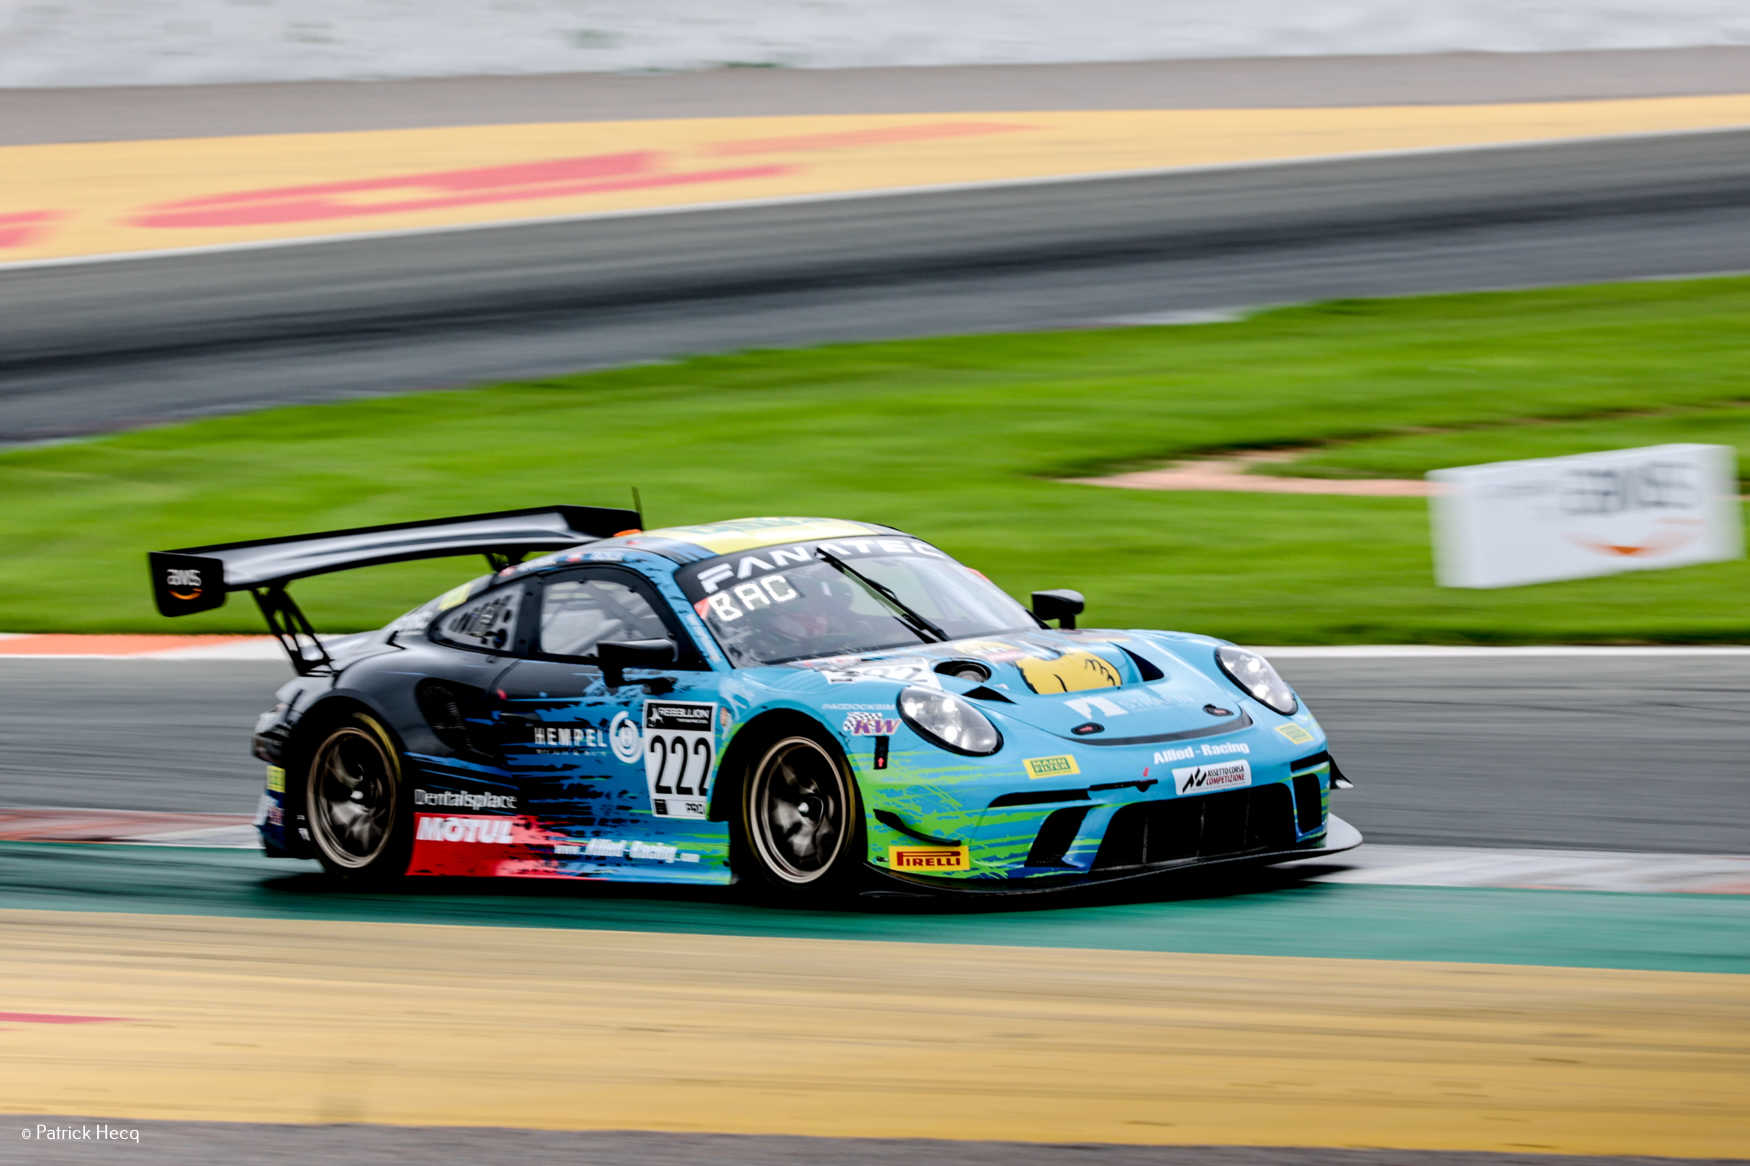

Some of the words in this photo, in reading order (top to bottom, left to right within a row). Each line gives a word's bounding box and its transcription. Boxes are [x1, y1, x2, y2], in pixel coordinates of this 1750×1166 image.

[697, 539, 948, 594] FANATEC
[707, 574, 798, 623] BAC
[658, 706, 710, 719] REBELLION
[534, 727, 608, 748] HEMPEL
[853, 719, 902, 736] KW
[650, 734, 712, 797] 222
[416, 816, 513, 844] MOTUL
[896, 851, 961, 867] PIRELLI
